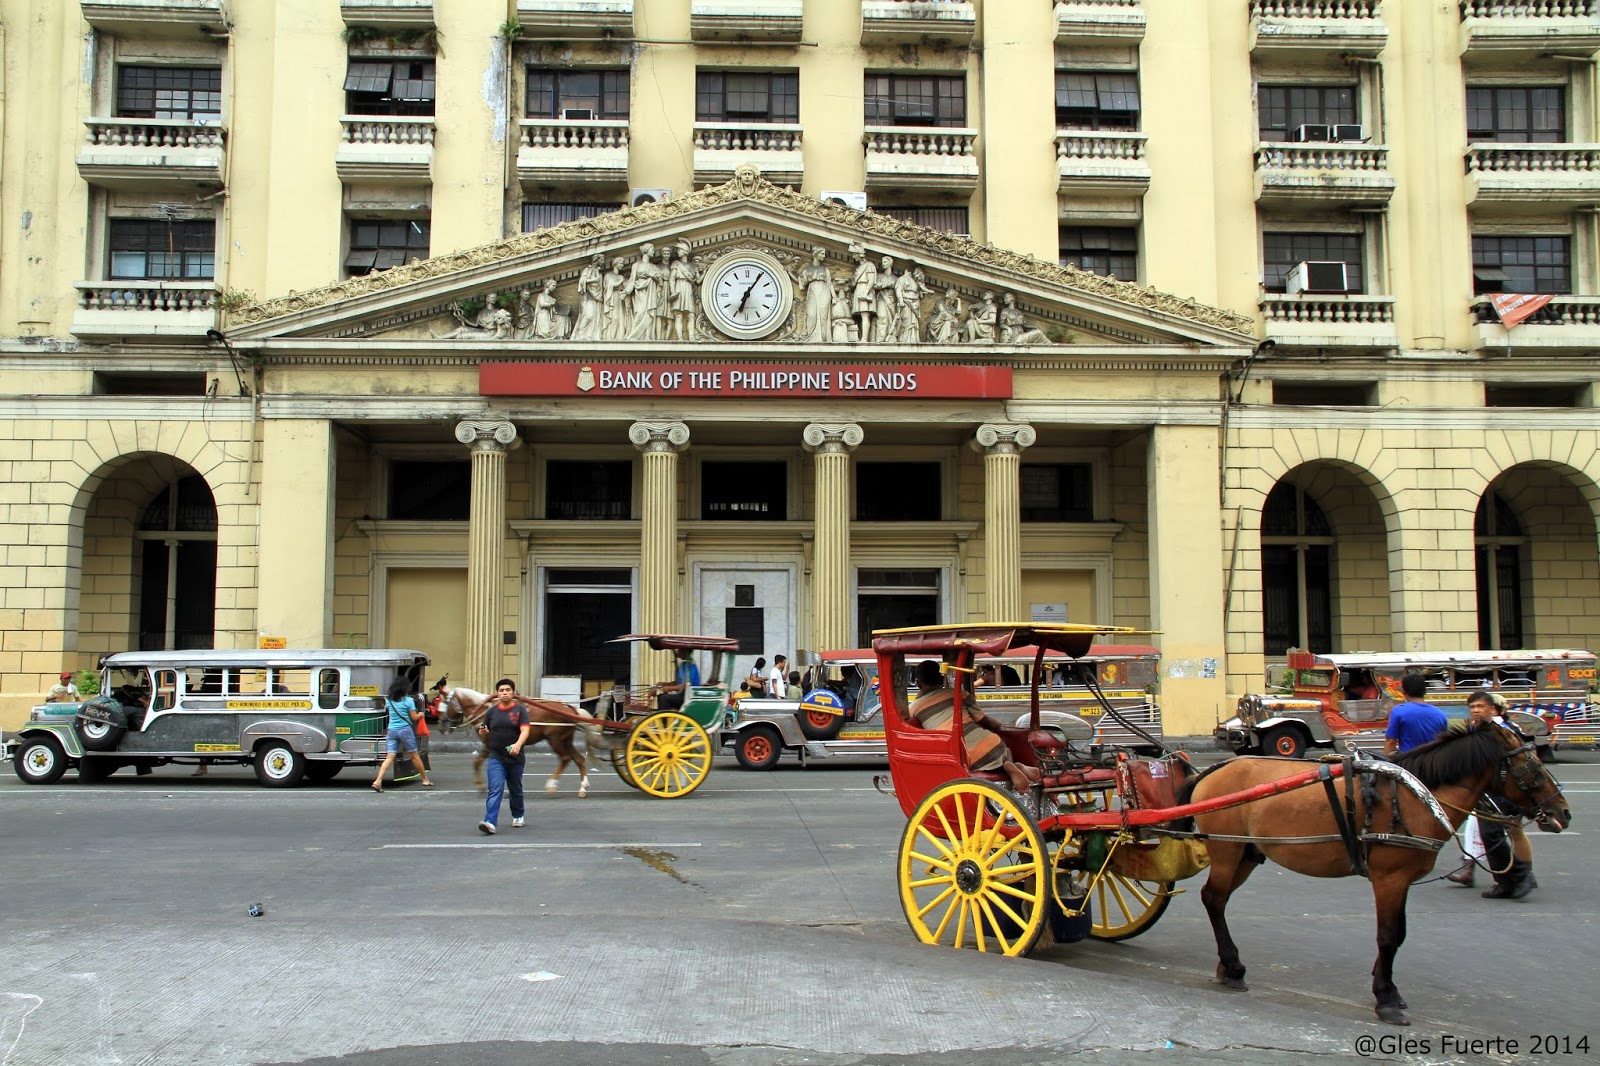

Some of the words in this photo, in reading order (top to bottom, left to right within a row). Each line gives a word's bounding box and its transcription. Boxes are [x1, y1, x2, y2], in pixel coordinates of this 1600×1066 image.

[599, 370, 653, 389] BANK
[660, 371, 683, 389] OF
[689, 371, 722, 389] THE
[730, 370, 830, 390] PHILIPPINE
[838, 371, 917, 391] ISLANDS
